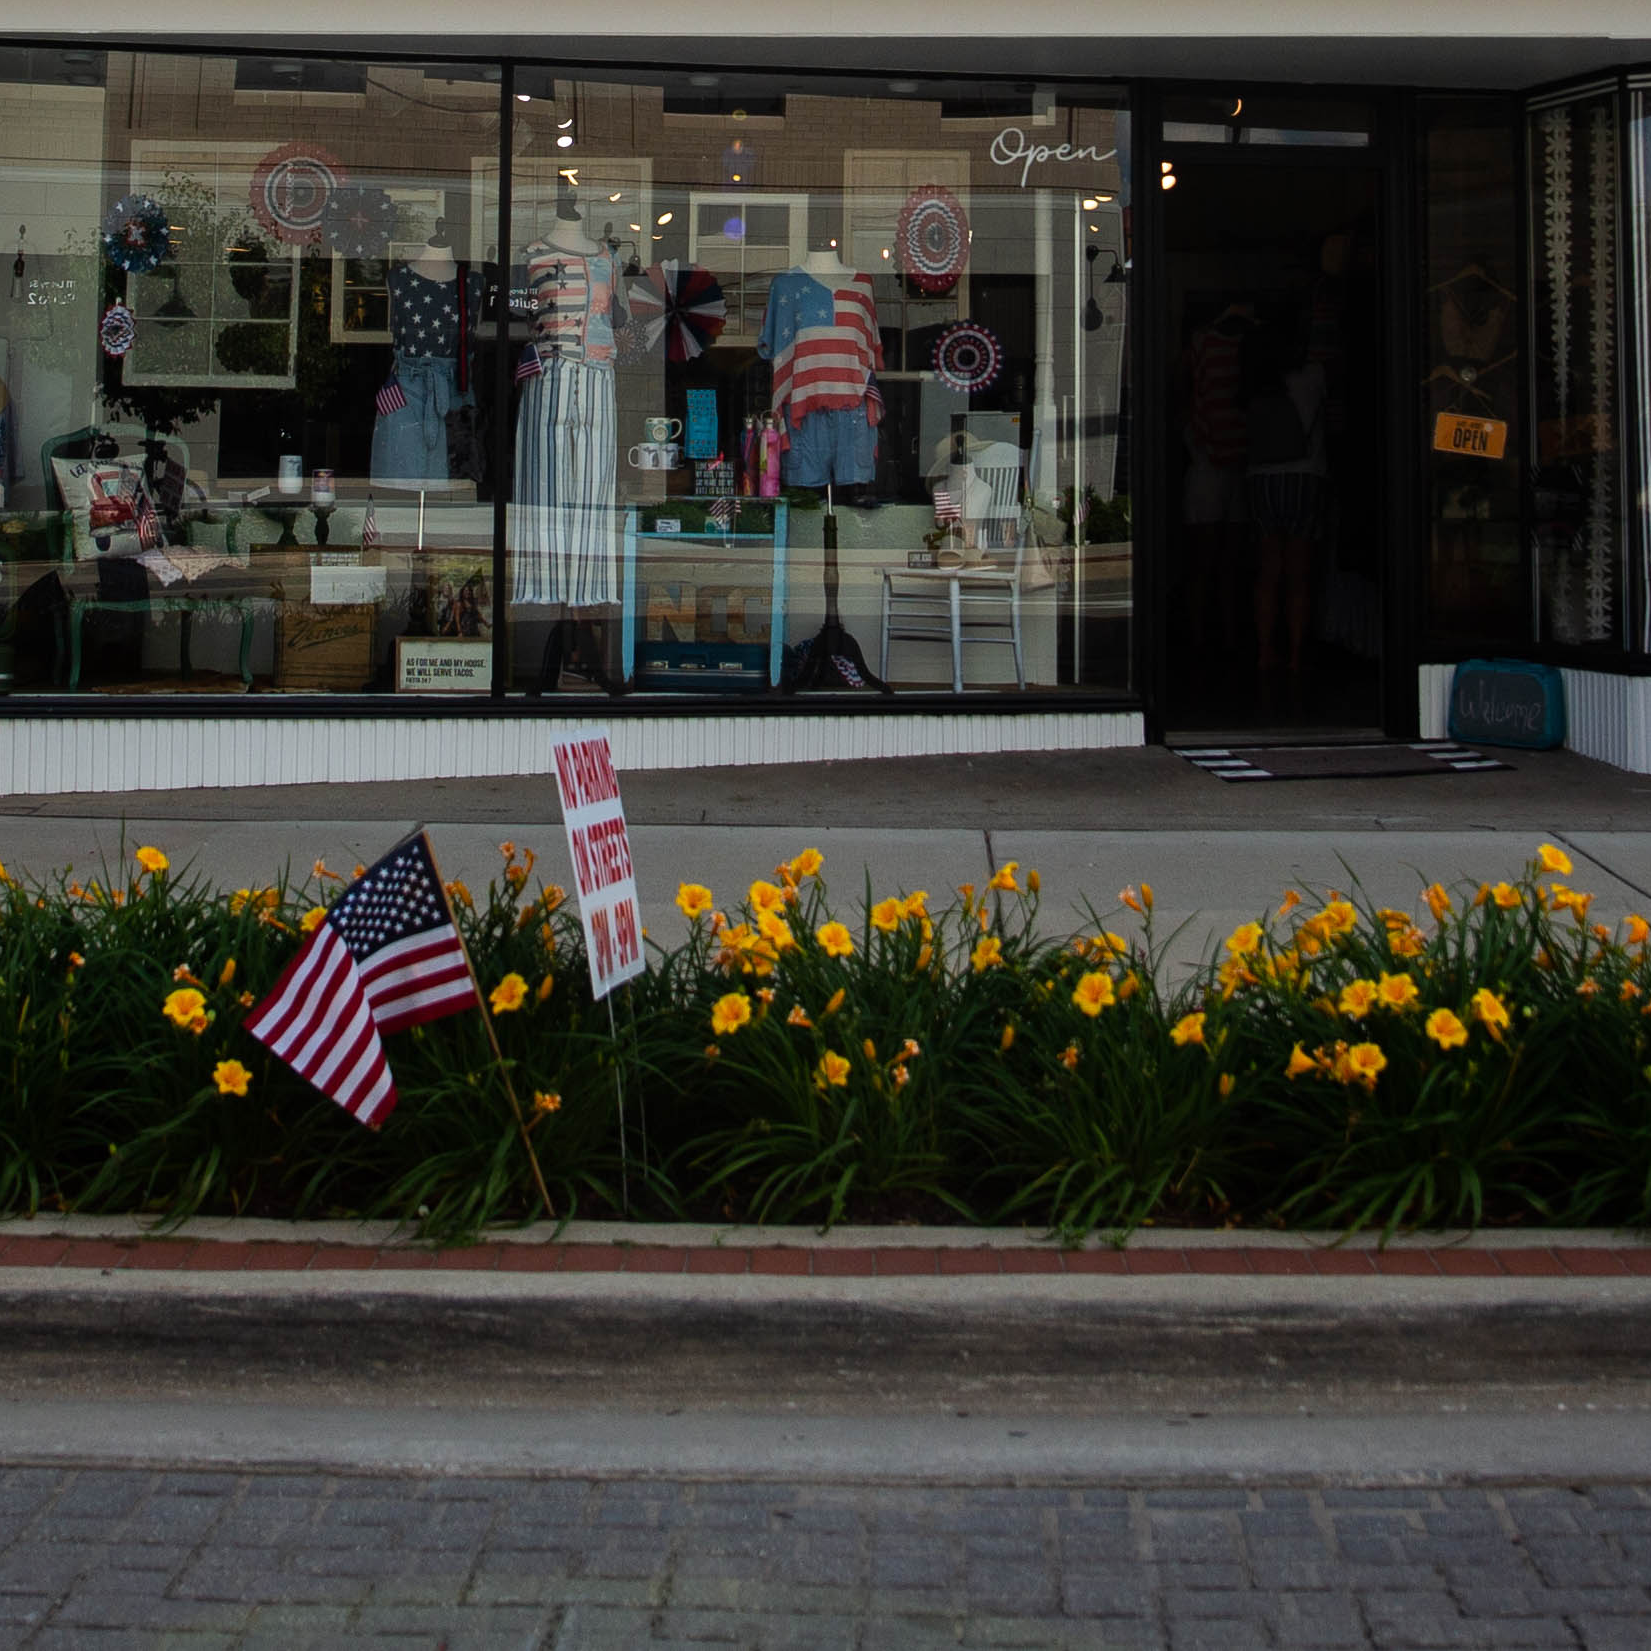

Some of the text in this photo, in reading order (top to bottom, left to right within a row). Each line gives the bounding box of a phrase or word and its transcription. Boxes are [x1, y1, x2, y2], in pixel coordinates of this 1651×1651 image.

[989, 127, 1118, 189] Open
[1454, 427, 1487, 451] OPEN
[406, 657, 415, 666] AS
[416, 657, 428, 667] FOR
[429, 658, 439, 667] ME
[439, 658, 453, 667] AND
[453, 658, 464, 667] MY
[406, 667, 416, 676] WE
[417, 668, 431, 676] WILL
[433, 668, 453, 677] SERVE
[553, 736, 619, 810] NO PARKING
[572, 816, 633, 897] ON STREETS
